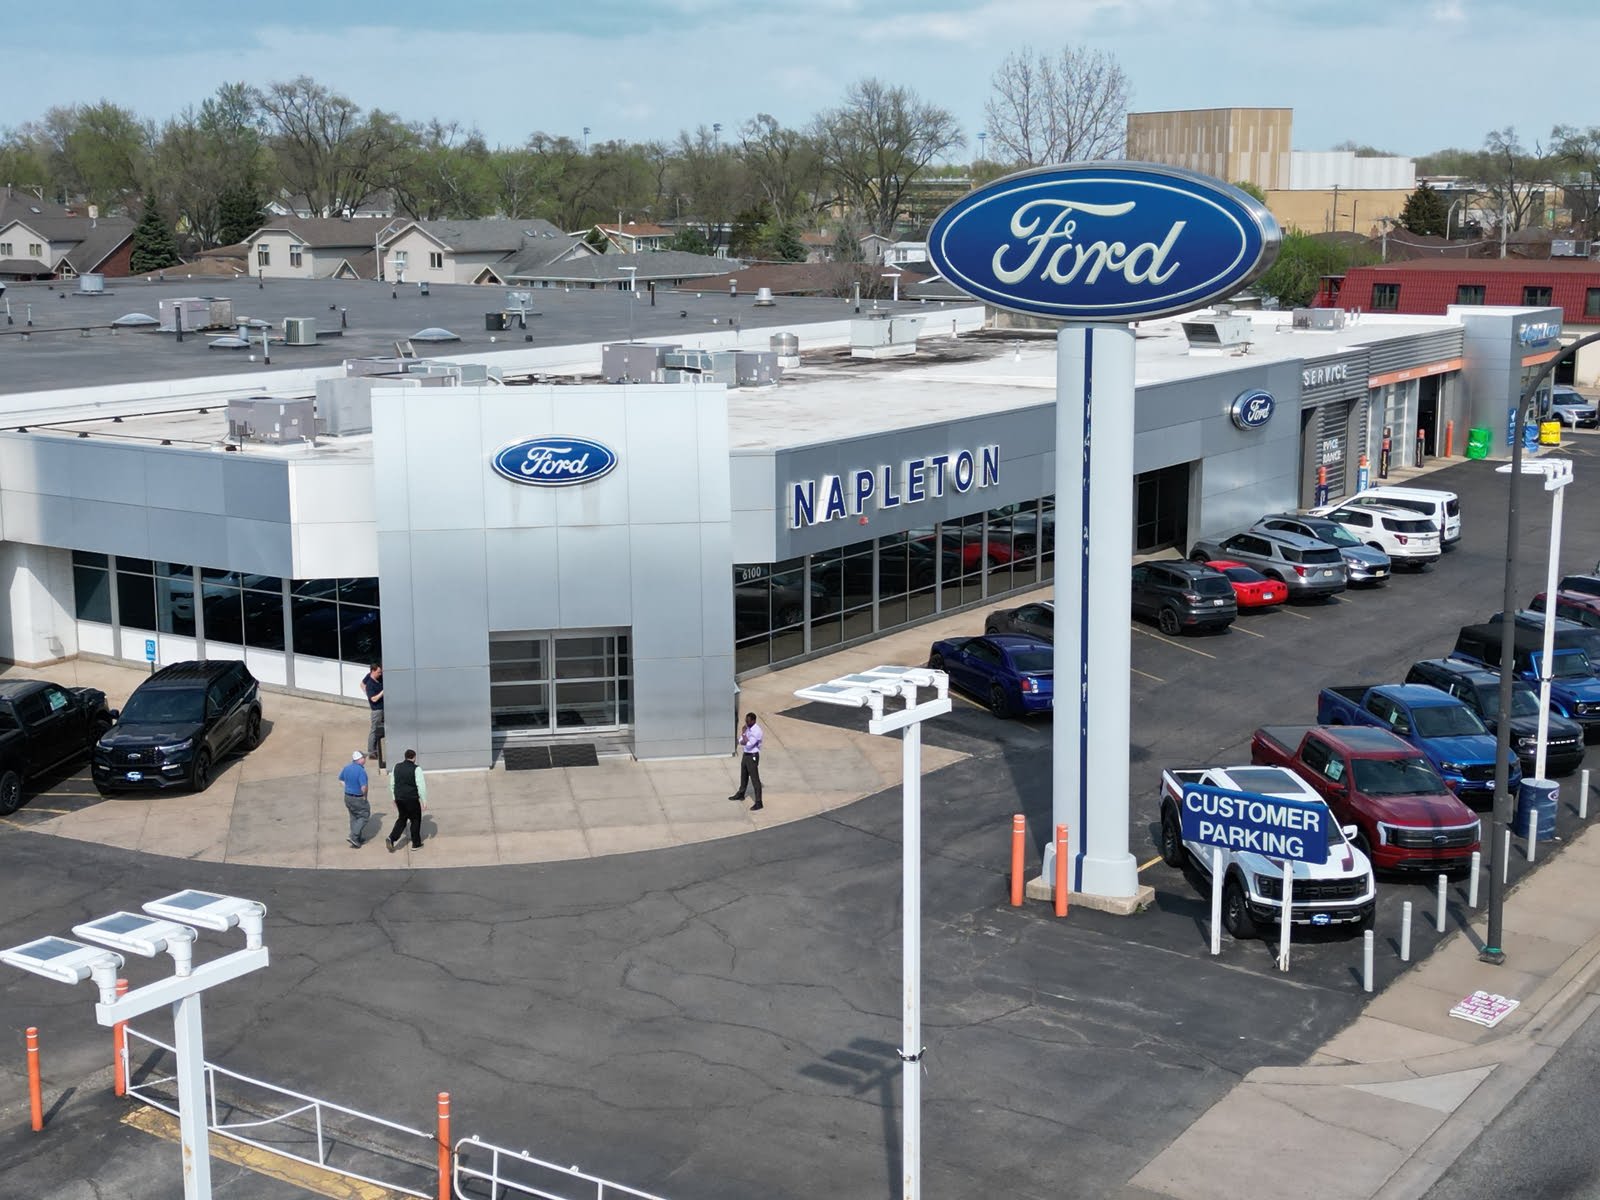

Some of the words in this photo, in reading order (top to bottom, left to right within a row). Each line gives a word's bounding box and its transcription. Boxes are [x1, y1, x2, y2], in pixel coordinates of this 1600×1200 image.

[991, 198, 1187, 286] Ford
[1302, 364, 1347, 386] SERVICE
[1247, 399, 1271, 422] Ford
[520, 446, 590, 475] Ford
[791, 445, 1000, 529] NAPLETON
[742, 566, 762, 580] 6100
[1186, 791, 1321, 832] CUSTOMER
[1199, 820, 1304, 858] PARKING
